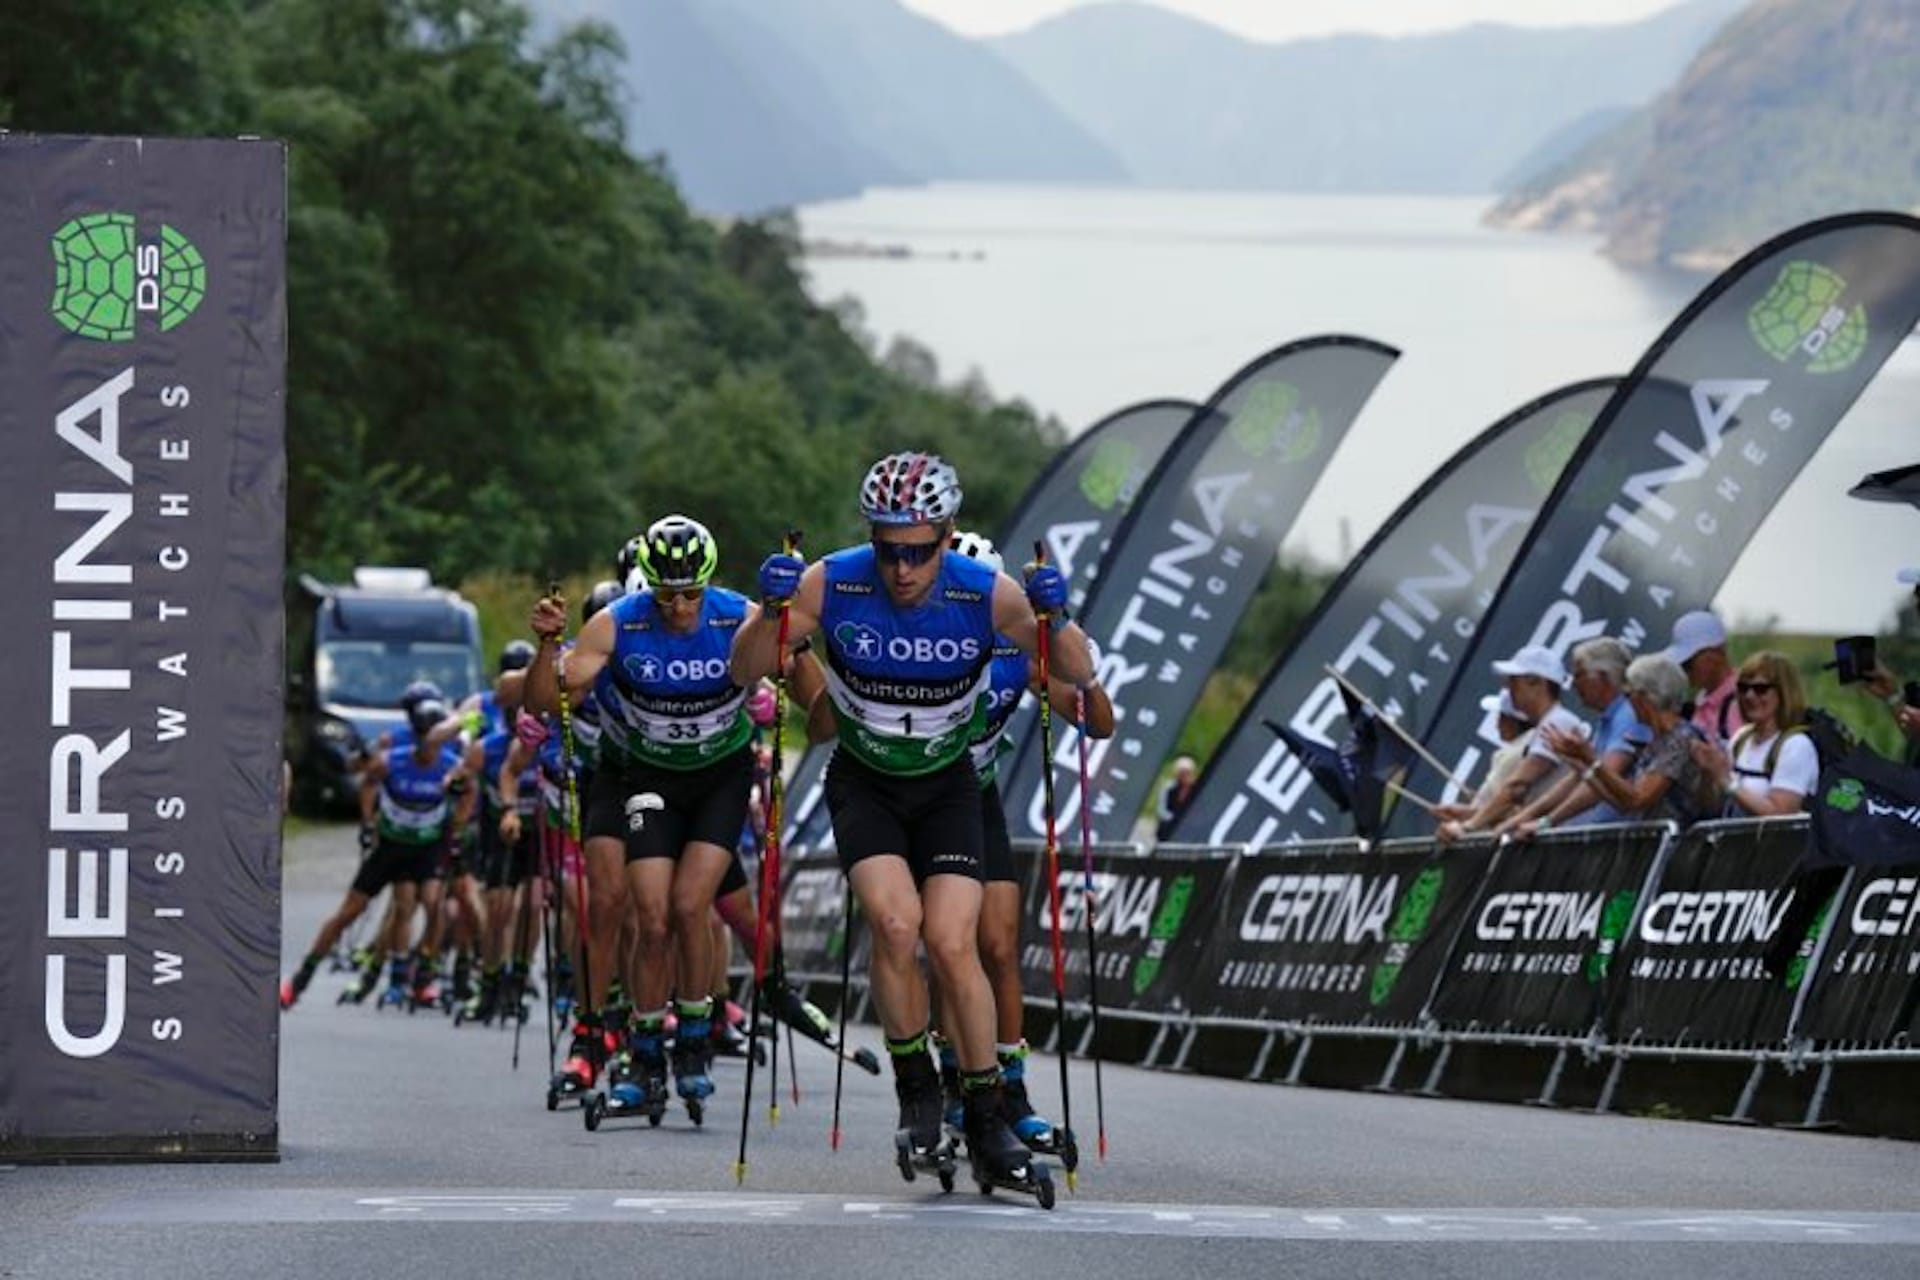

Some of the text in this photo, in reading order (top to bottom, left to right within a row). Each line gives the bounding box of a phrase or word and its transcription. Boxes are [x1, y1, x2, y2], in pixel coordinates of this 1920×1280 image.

[137, 243, 160, 311] DS
[1803, 304, 1846, 355] DS
[1617, 406, 1796, 652] WATCHES
[666, 658, 732, 681] OBO
[888, 636, 980, 664] OBOS
[45, 366, 136, 1058] CERTINA
[152, 385, 190, 1041] SWISS WATCHES
[668, 722, 700, 739] 33
[896, 712, 912, 736] 1
[1239, 872, 1400, 944] CERTINA
[1475, 890, 1606, 941] CERTINA
[1218, 960, 1366, 992] SWISS WATCHES
[1690, 957, 1773, 981] WATCHE
